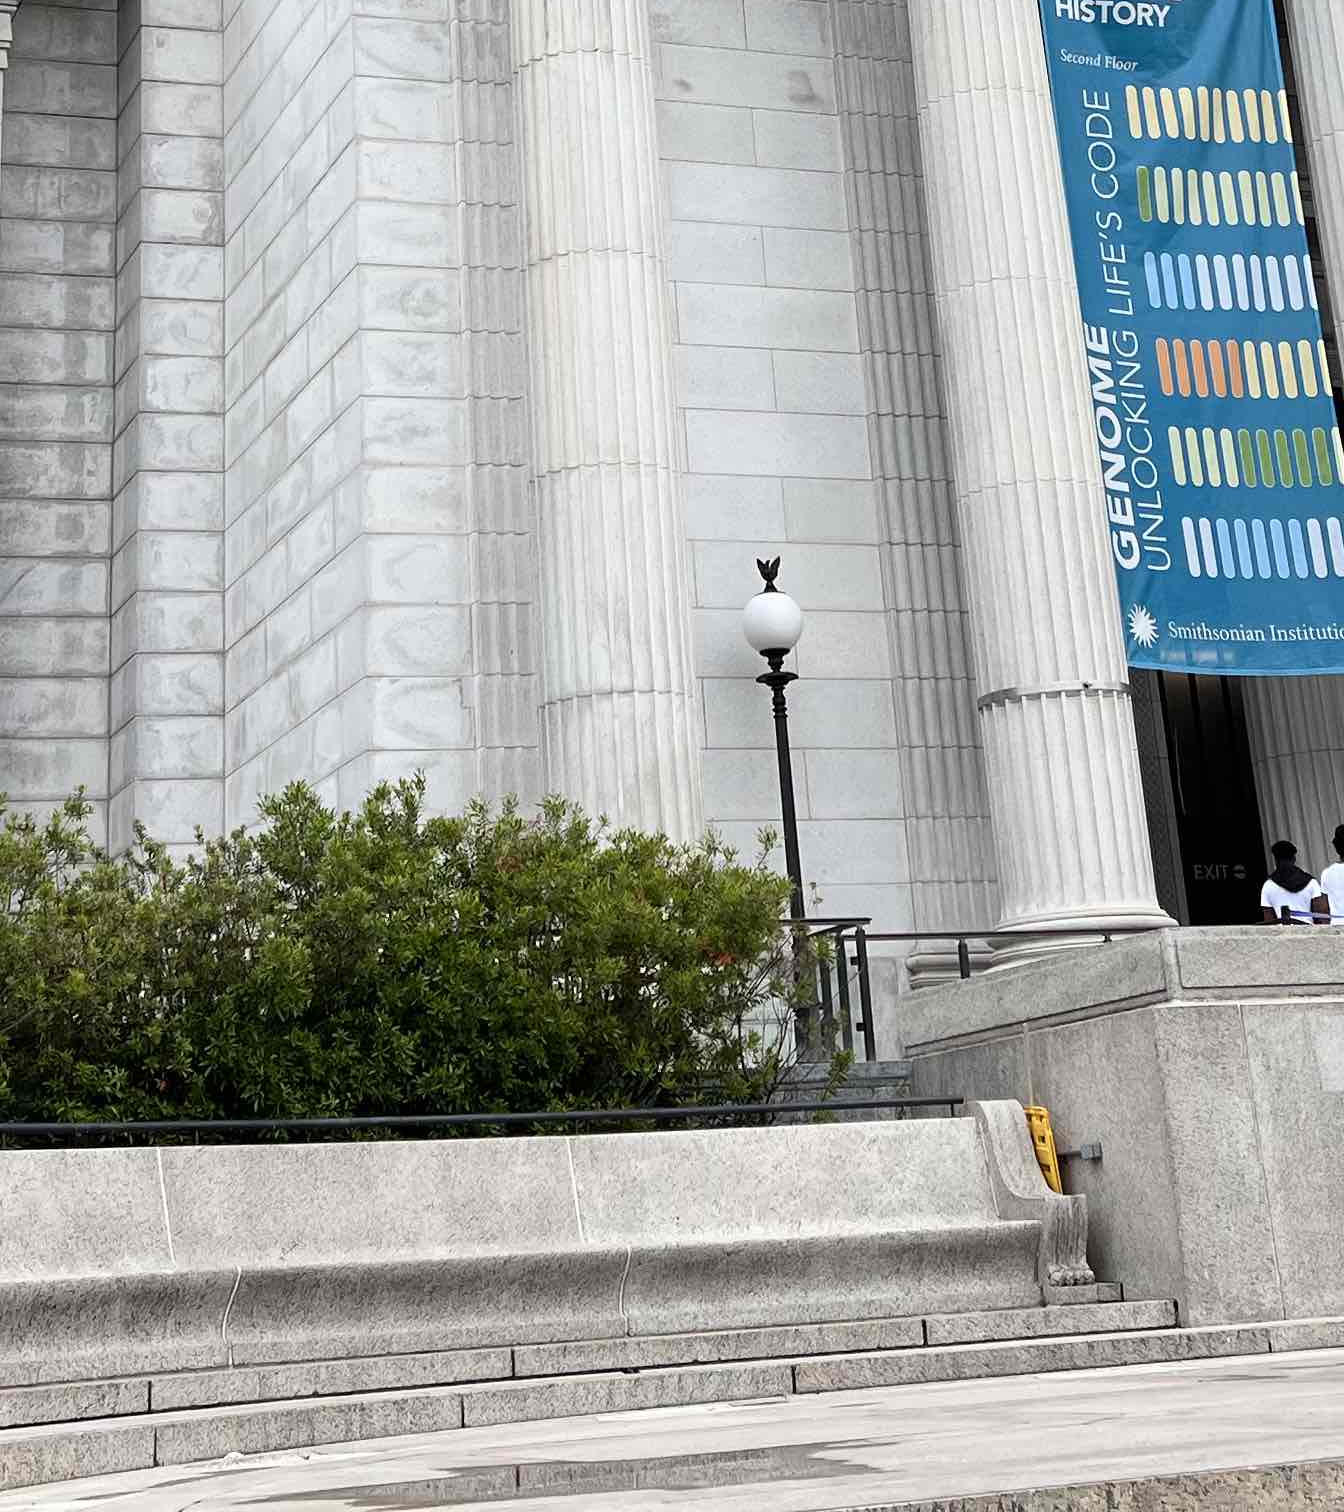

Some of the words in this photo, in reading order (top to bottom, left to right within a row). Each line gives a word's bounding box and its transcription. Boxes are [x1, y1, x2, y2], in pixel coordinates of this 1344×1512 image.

[1060, 48, 1101, 67] Second
[1105, 55, 1139, 72] Floor
[1083, 88, 1119, 199] CODE
[1096, 210, 1135, 316] LIFE'S
[1084, 322, 1141, 570] GENOME
[1112, 330, 1172, 571] UNLOCKING
[1167, 620, 1265, 642] Smithsonian
[1193, 864, 1230, 880] EXIT
